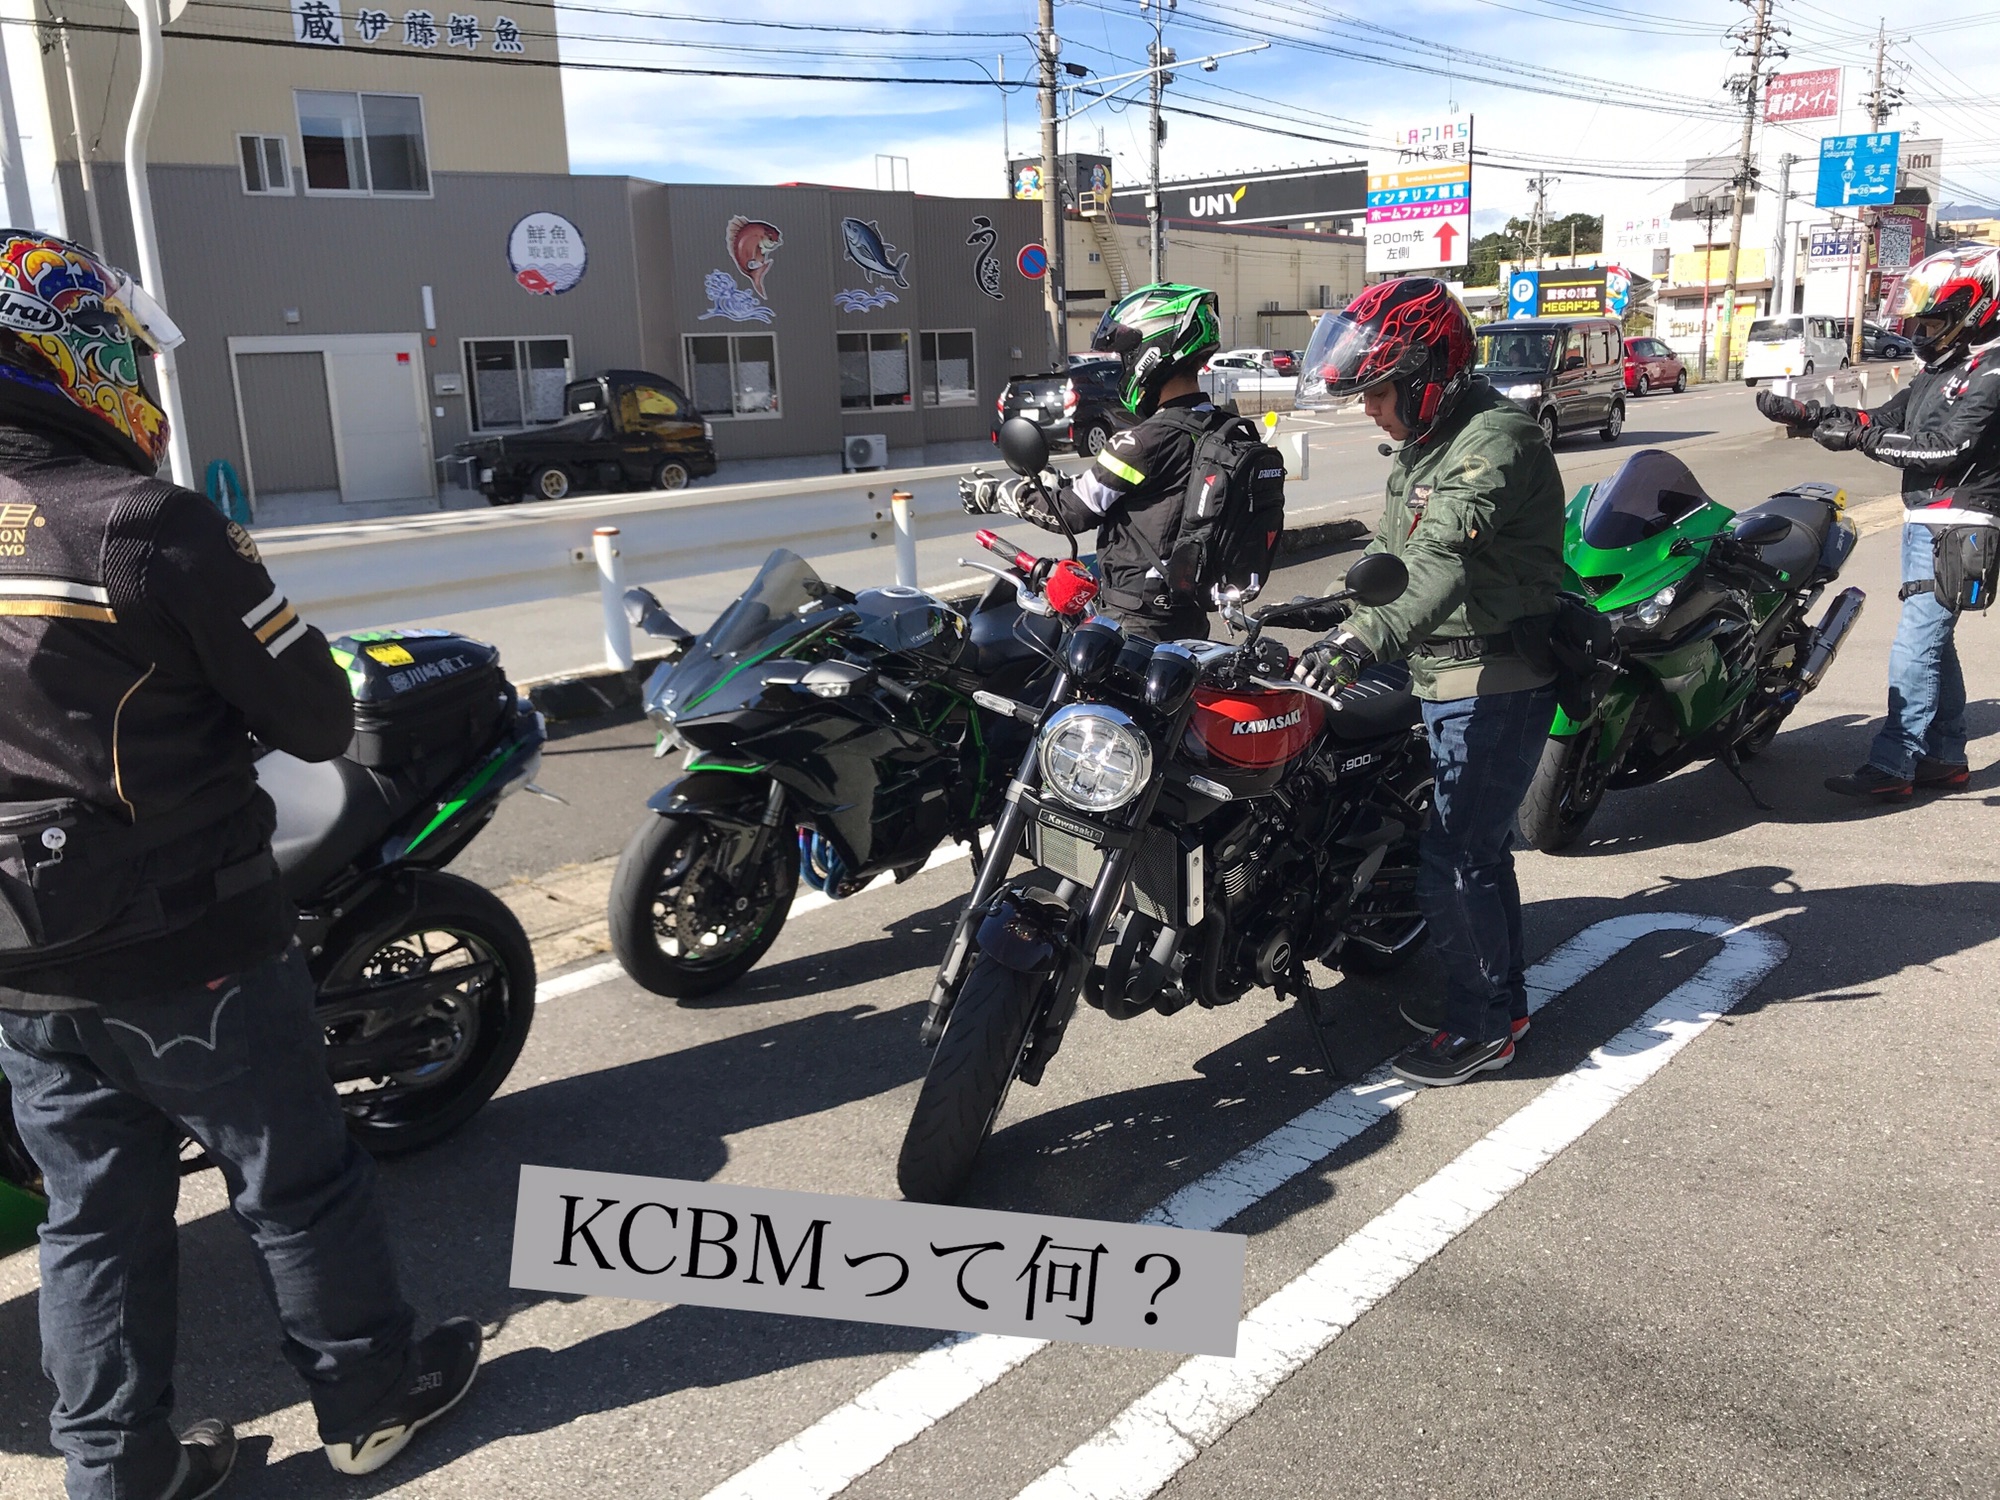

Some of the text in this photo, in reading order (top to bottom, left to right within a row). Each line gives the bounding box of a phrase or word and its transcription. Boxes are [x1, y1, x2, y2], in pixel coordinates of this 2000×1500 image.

[360, 10, 523, 51] 伊藤鮮魚
[1766, 89, 1837, 116] 賃貸メイト
[1866, 134, 1892, 148] 東員
[1398, 141, 1466, 165] 万代家具
[1864, 163, 1891, 177] 多度
[1371, 183, 1465, 206] インテリア雑貨
[1858, 186, 1870, 194] 26
[1189, 186, 1246, 217] UNY
[1371, 201, 1465, 222] ホームファッション
[527, 225, 569, 244] 鮮魚
[1373, 229, 1424, 245] 200m先
[528, 246, 570, 259] 取扱店
[1386, 246, 1410, 260] 左側
[1812, 243, 1861, 255] のトライ
[1542, 301, 1600, 313] MEGAドンキ
[1967, 299, 1990, 326] SHOEI
[1138, 350, 1159, 374] SHOEI
[1875, 447, 1900, 457] MOTO
[406, 654, 472, 686] 川崎重工
[1232, 709, 1302, 735] KAWASAKI
[1047, 814, 1094, 838] Kawasaki
